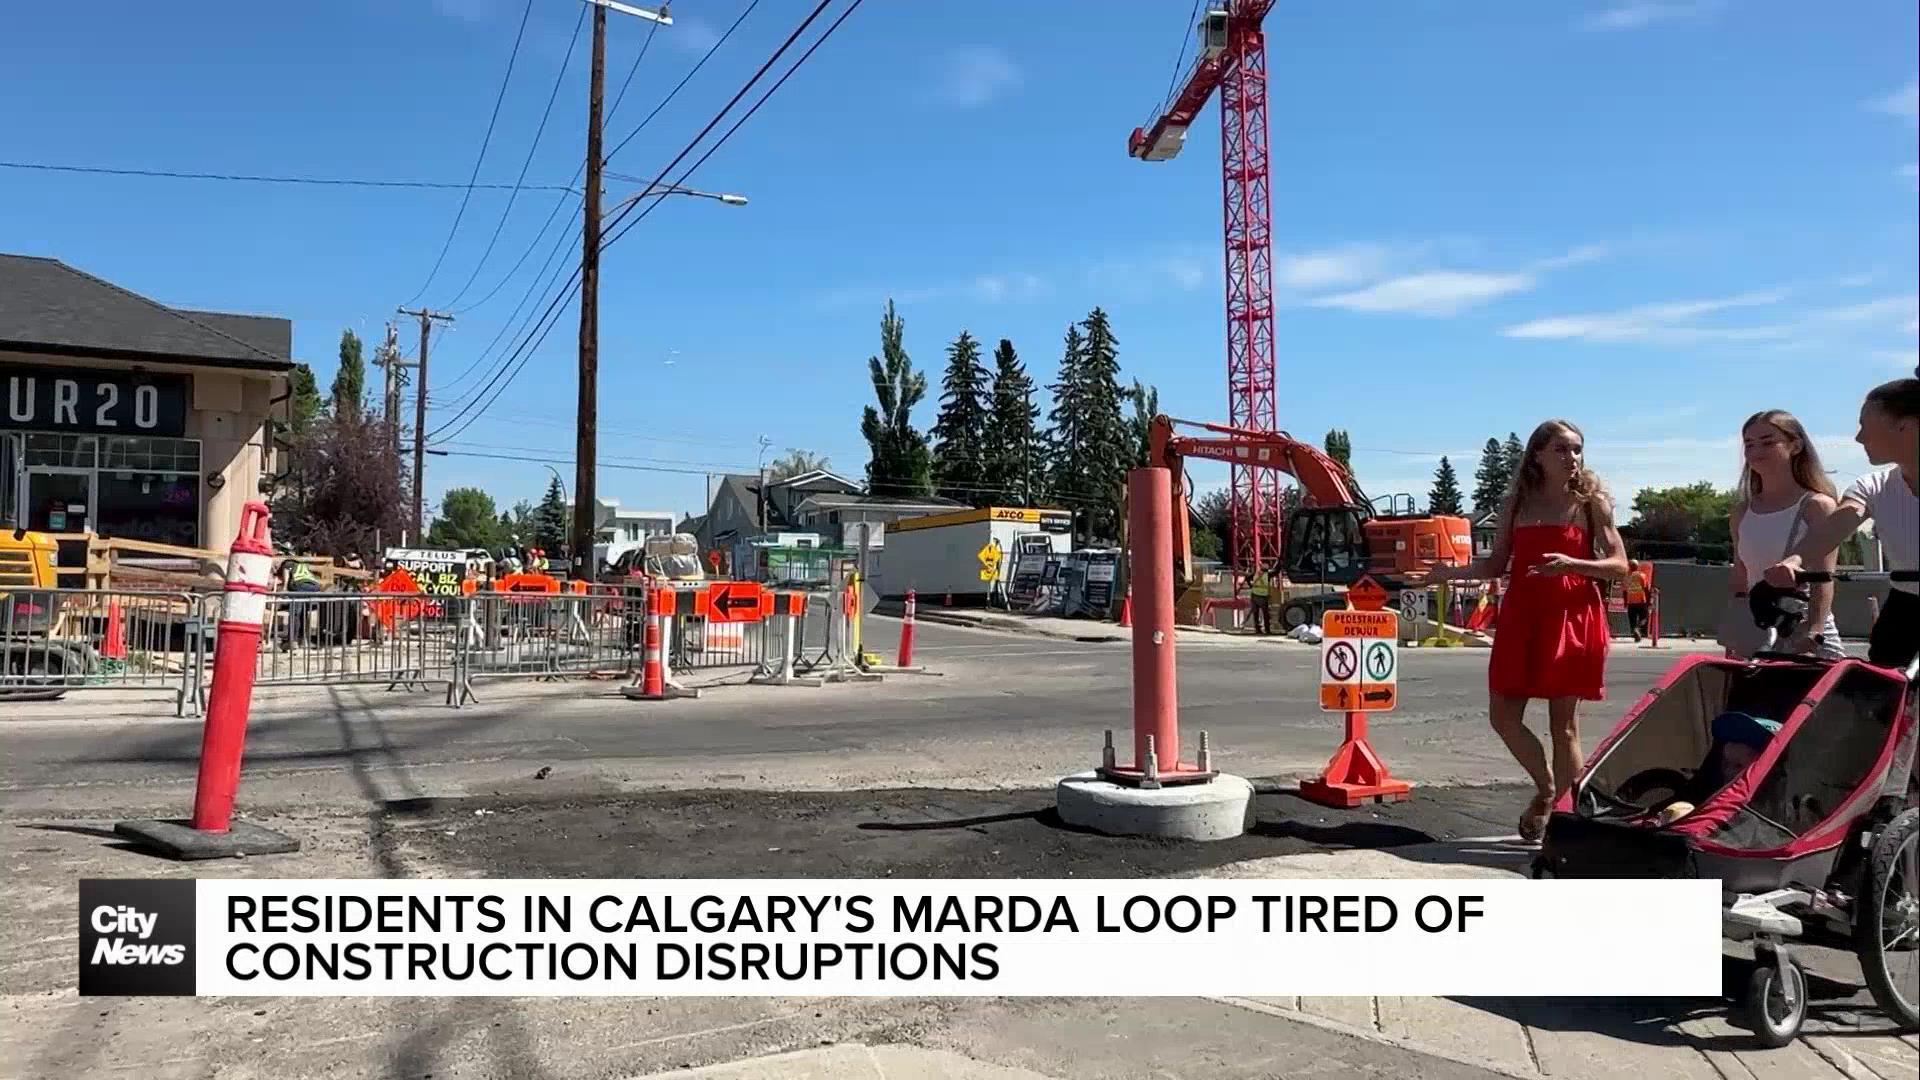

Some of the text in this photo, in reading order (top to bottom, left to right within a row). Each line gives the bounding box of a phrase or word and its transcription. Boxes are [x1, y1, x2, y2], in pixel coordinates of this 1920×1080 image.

[9, 376, 158, 428] UR20
[1192, 446, 1233, 457] HITACHI
[996, 511, 1024, 520] ATCO
[420, 551, 457, 560] TELUS
[398, 561, 454, 574] SUPPORT
[439, 573, 457, 584] BIZ
[1334, 614, 1388, 623] PEDESTRIAN
[1344, 626, 1379, 636] DETOUR
